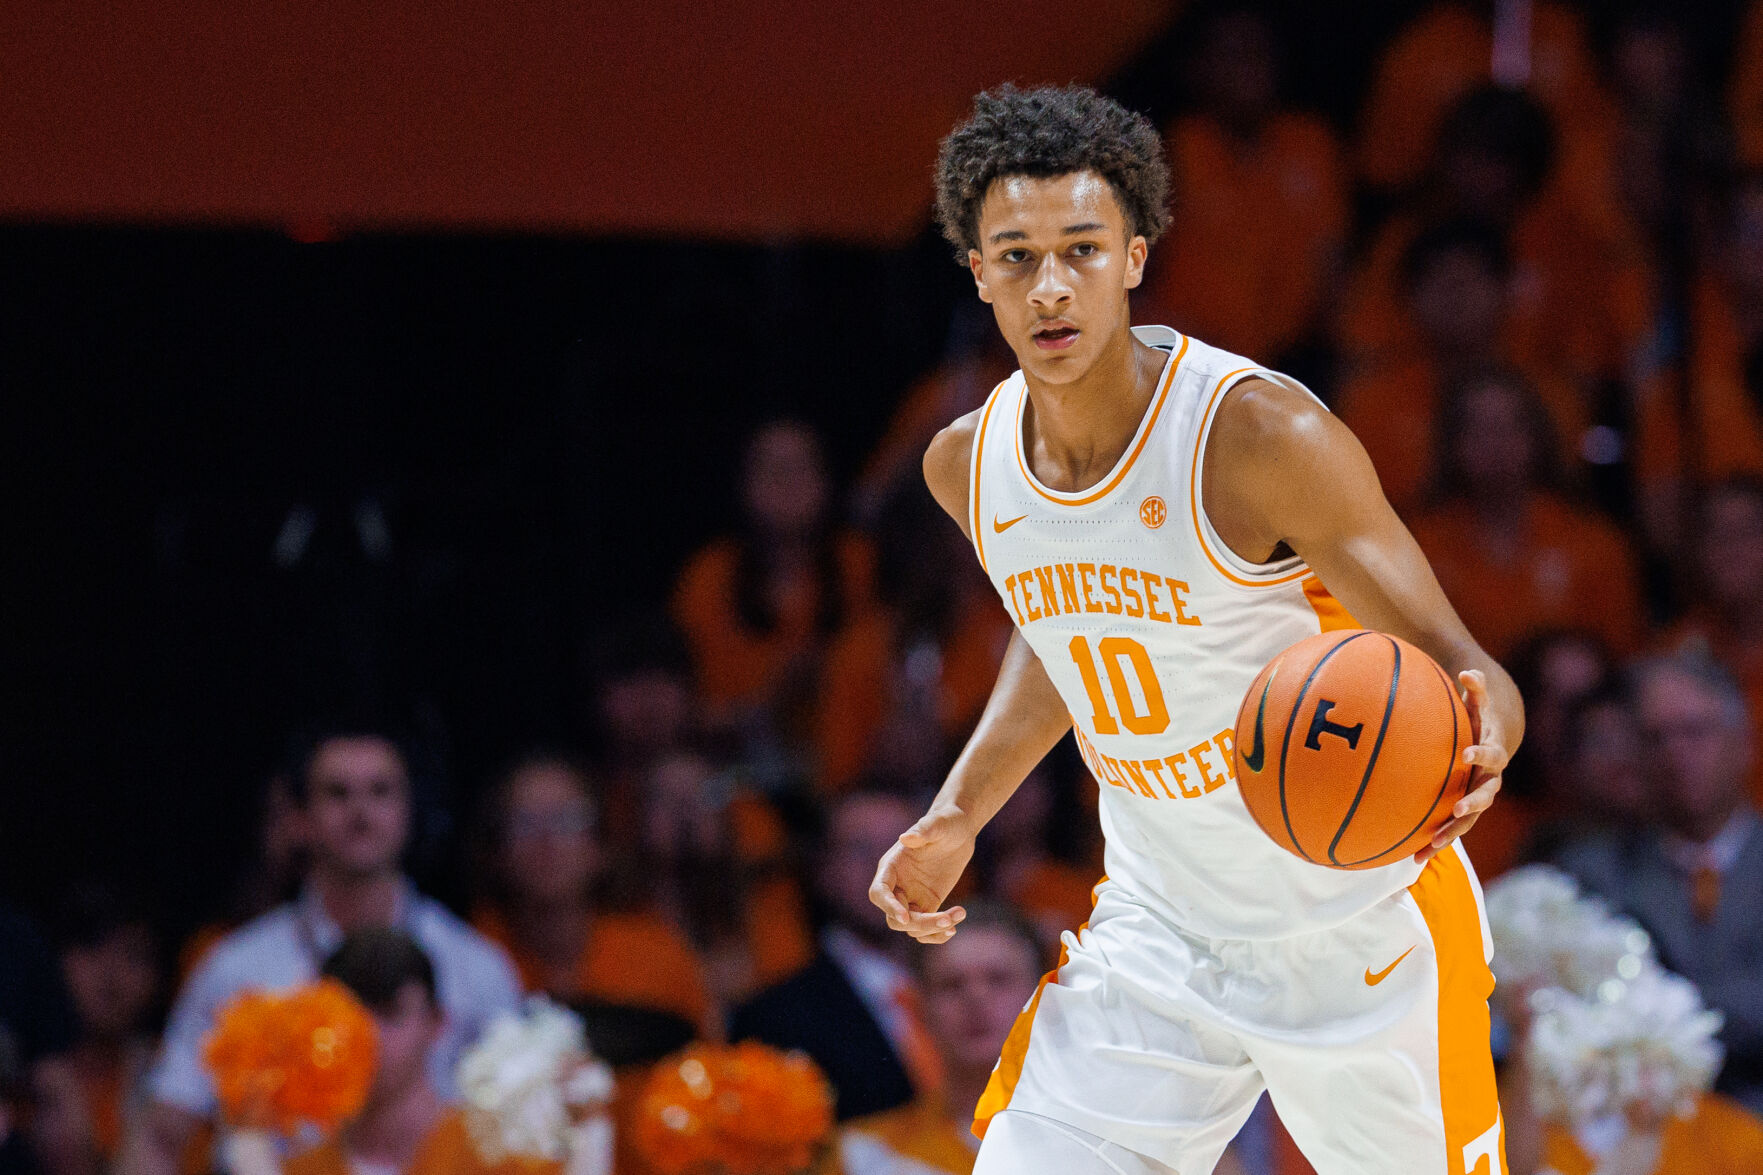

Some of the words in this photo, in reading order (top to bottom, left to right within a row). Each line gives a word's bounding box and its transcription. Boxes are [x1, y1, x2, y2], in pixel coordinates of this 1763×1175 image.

[1141, 498, 1165, 527] SEC
[1004, 562, 1203, 627] TENNESSEE
[1068, 635, 1171, 736] 10
[1303, 698, 1365, 752] T
